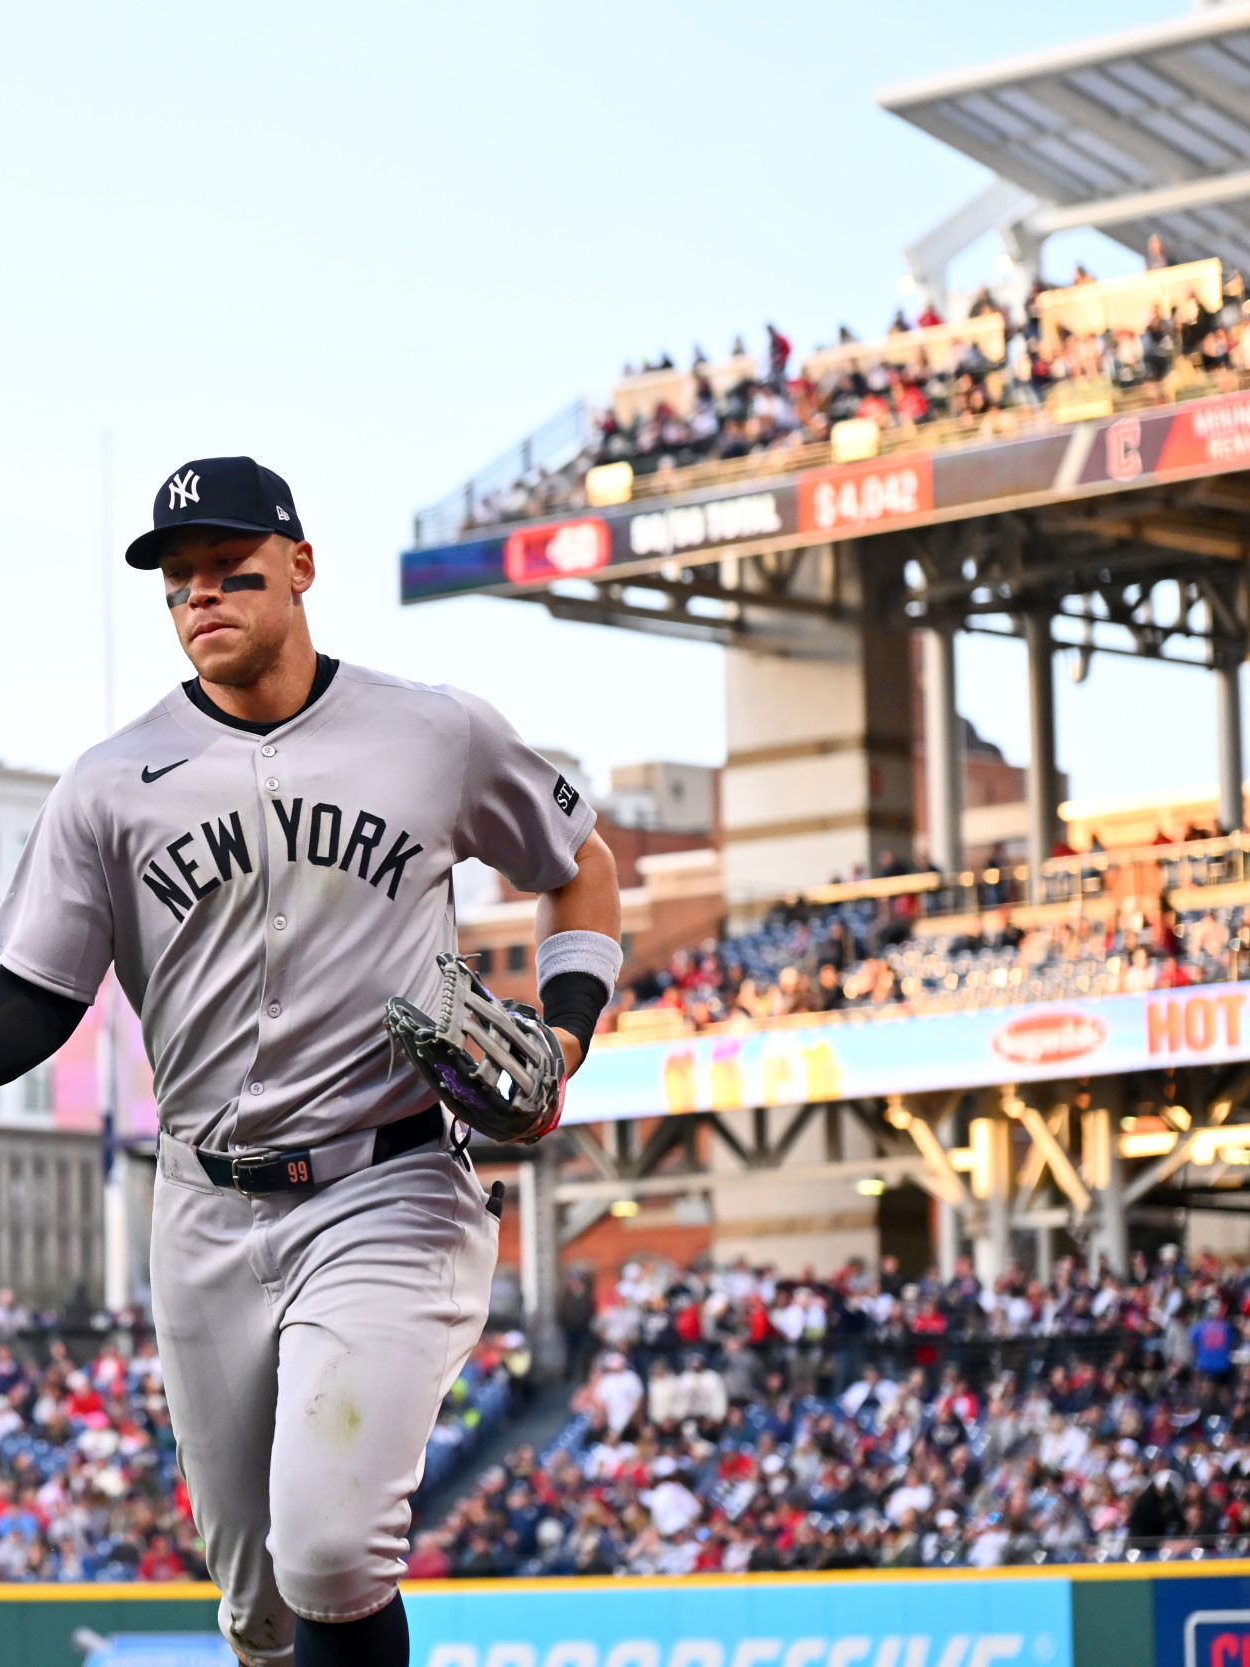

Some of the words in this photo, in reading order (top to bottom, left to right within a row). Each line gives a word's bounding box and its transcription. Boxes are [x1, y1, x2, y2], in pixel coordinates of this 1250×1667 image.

[143, 811, 253, 924] NEW
[273, 798, 424, 901] YORK
[1147, 992, 1247, 1055] HOT
[287, 1161, 309, 1183] 99
